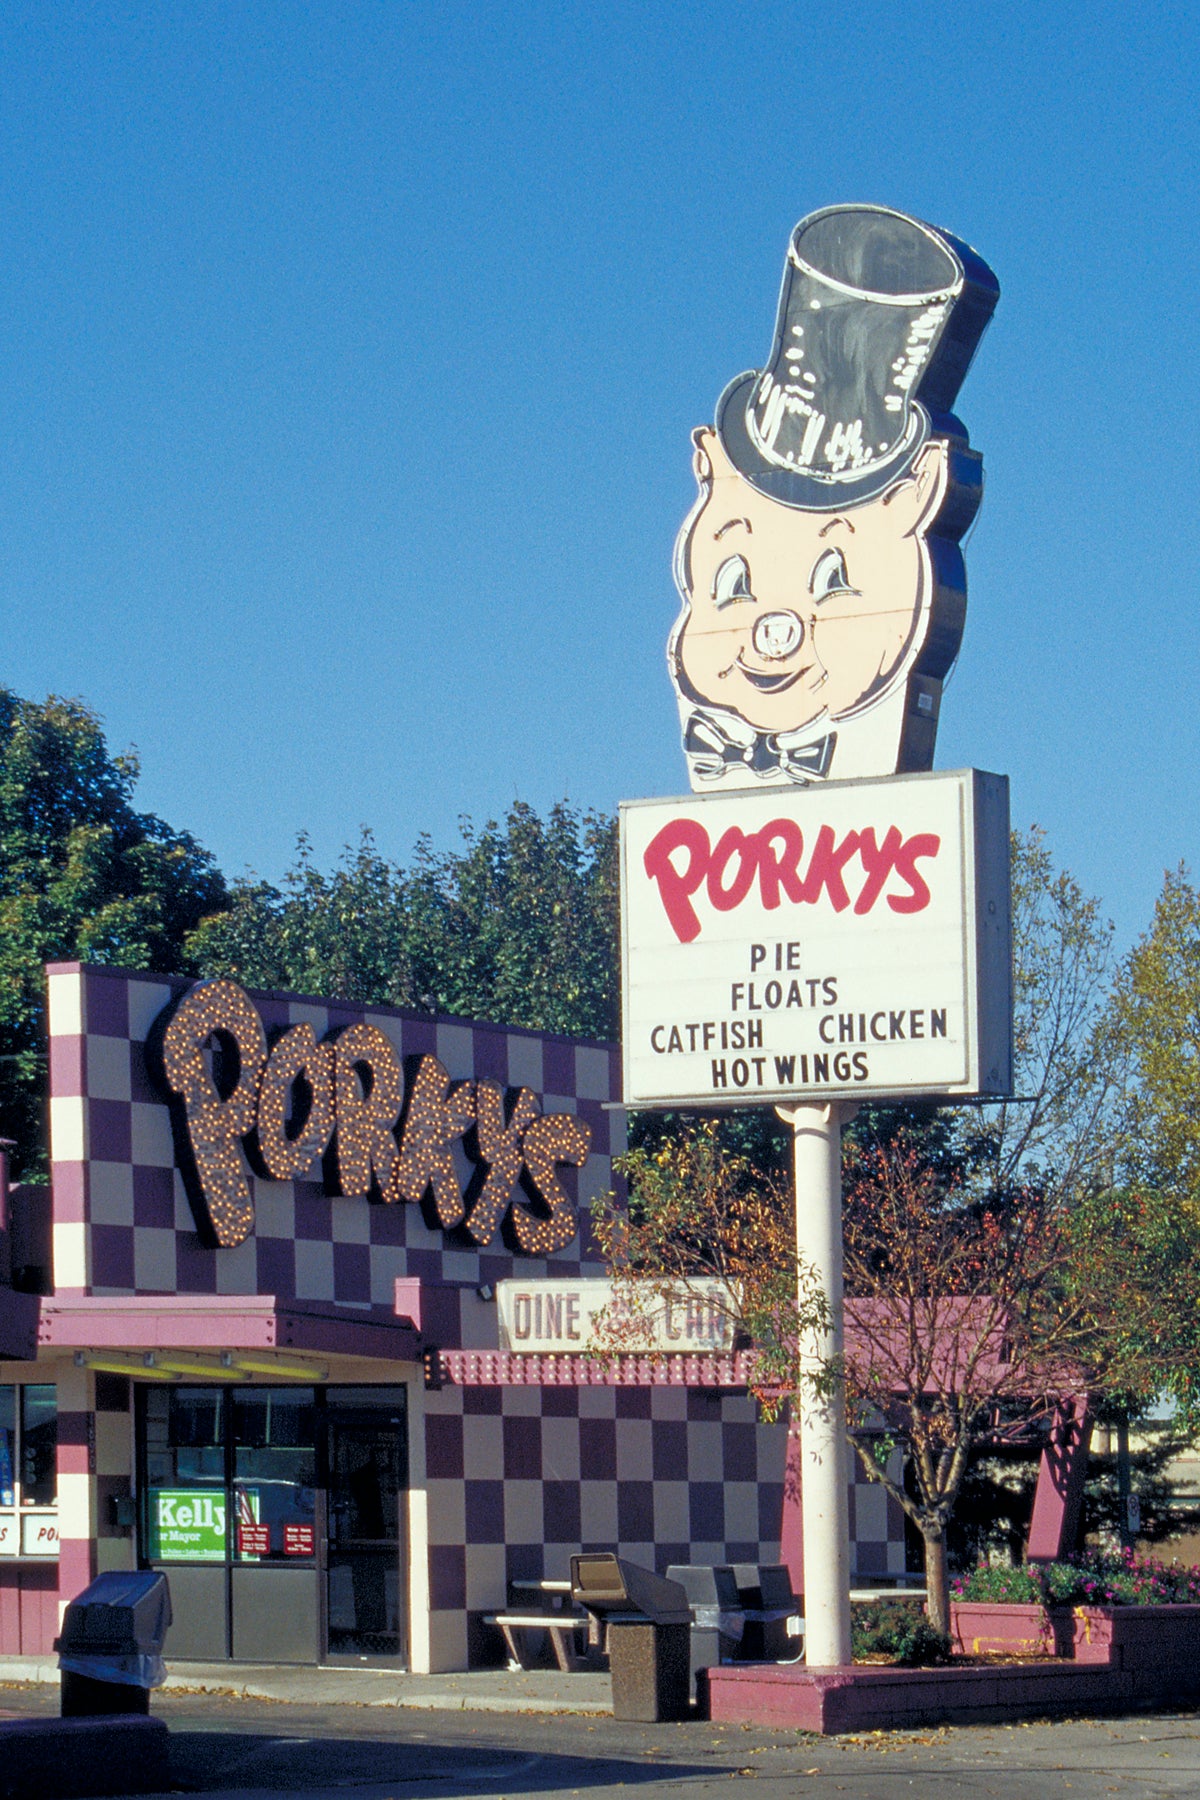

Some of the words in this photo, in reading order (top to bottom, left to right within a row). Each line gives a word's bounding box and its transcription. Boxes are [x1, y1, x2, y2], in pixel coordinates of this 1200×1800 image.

[643, 818, 941, 943] PORKYS
[750, 941, 801, 972] PIE
[731, 977, 838, 1011] FLOATS
[650, 1018, 763, 1053] CATFISH
[818, 1008, 947, 1043] CHICKEN
[711, 1057, 767, 1088] HOT
[775, 1051, 869, 1084] WINGS
[152, 978, 592, 1254] PORKYS
[514, 1292, 581, 1341] DINE
[156, 1498, 225, 1536] Kelly
